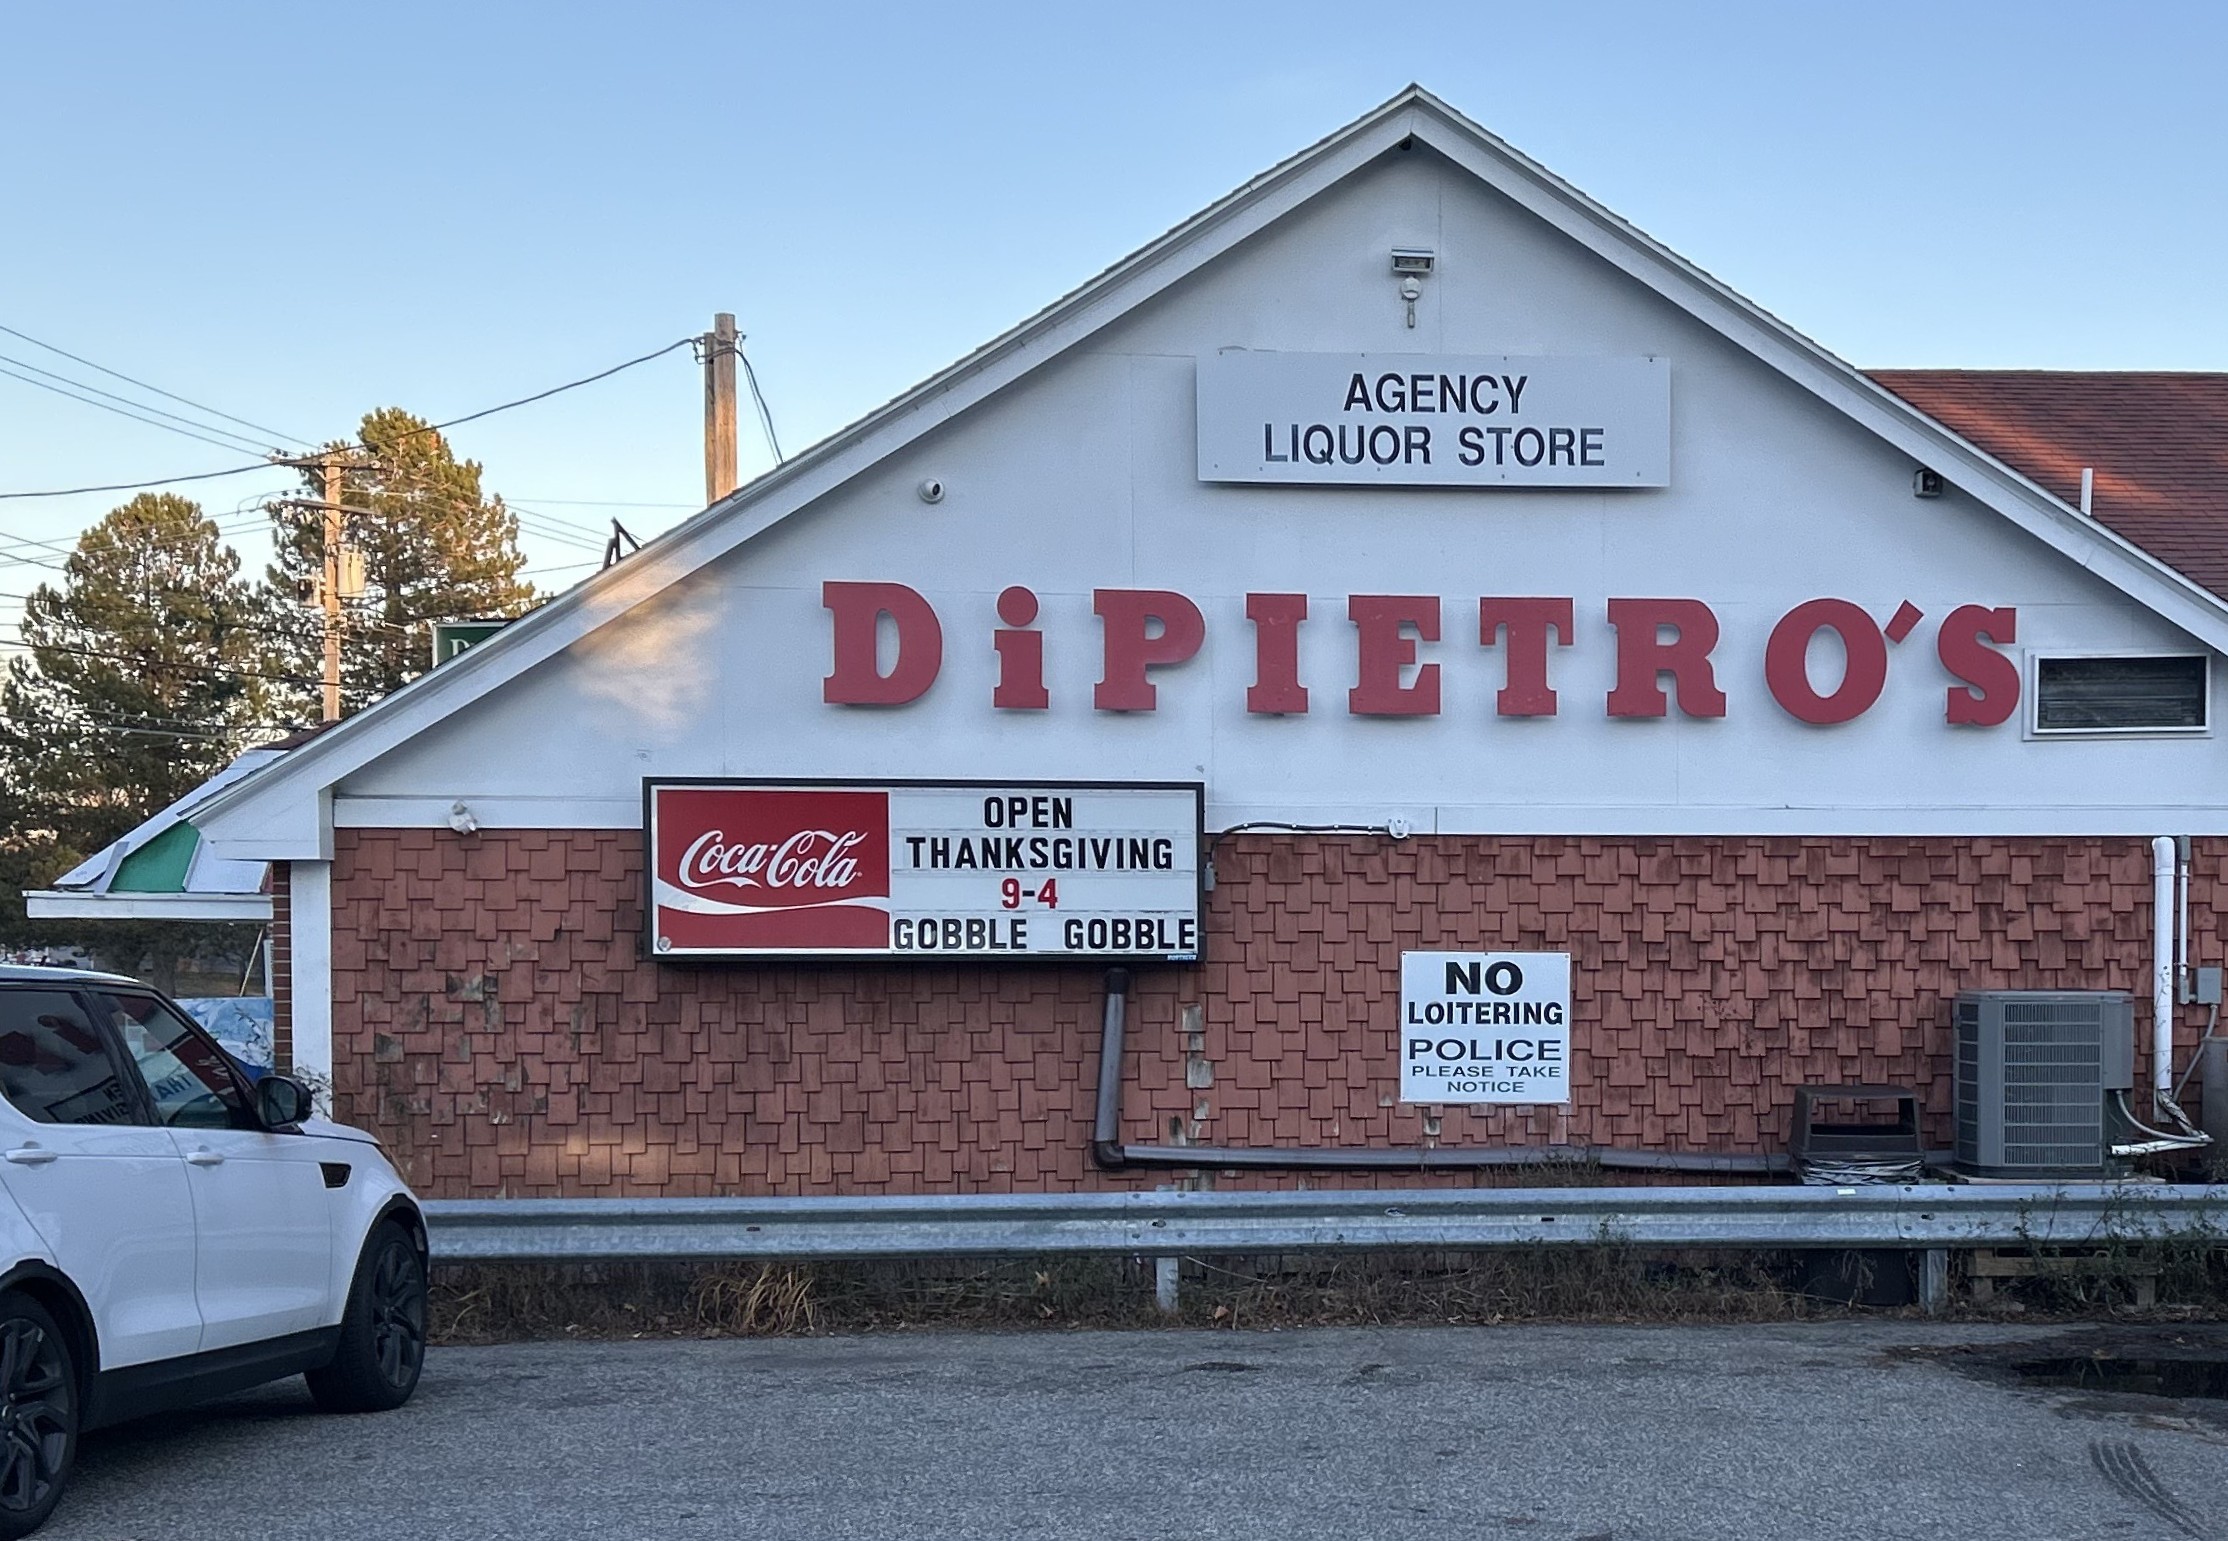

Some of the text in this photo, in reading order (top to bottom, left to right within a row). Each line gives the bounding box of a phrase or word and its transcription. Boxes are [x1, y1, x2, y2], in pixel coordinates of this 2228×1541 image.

[1343, 373, 1528, 415] AGENCY
[1264, 423, 1605, 467] LIQUOR STORE
[822, 581, 2021, 727] DiPIETRO'S
[983, 796, 1073, 829] OPEN
[678, 829, 868, 889] Coca-Cola
[906, 837, 1173, 870] THANKSGIVING
[1001, 877, 1058, 910] 9-4
[893, 917, 1196, 951] GOBBLE GOBBLE
[1445, 960, 1523, 996] NO
[1408, 1001, 1563, 1025] LOITERING
[1409, 1038, 1562, 1061] POLICE
[1412, 1065, 1561, 1078] PLEASE TAKE
[1447, 1081, 1526, 1093] NOTICE
